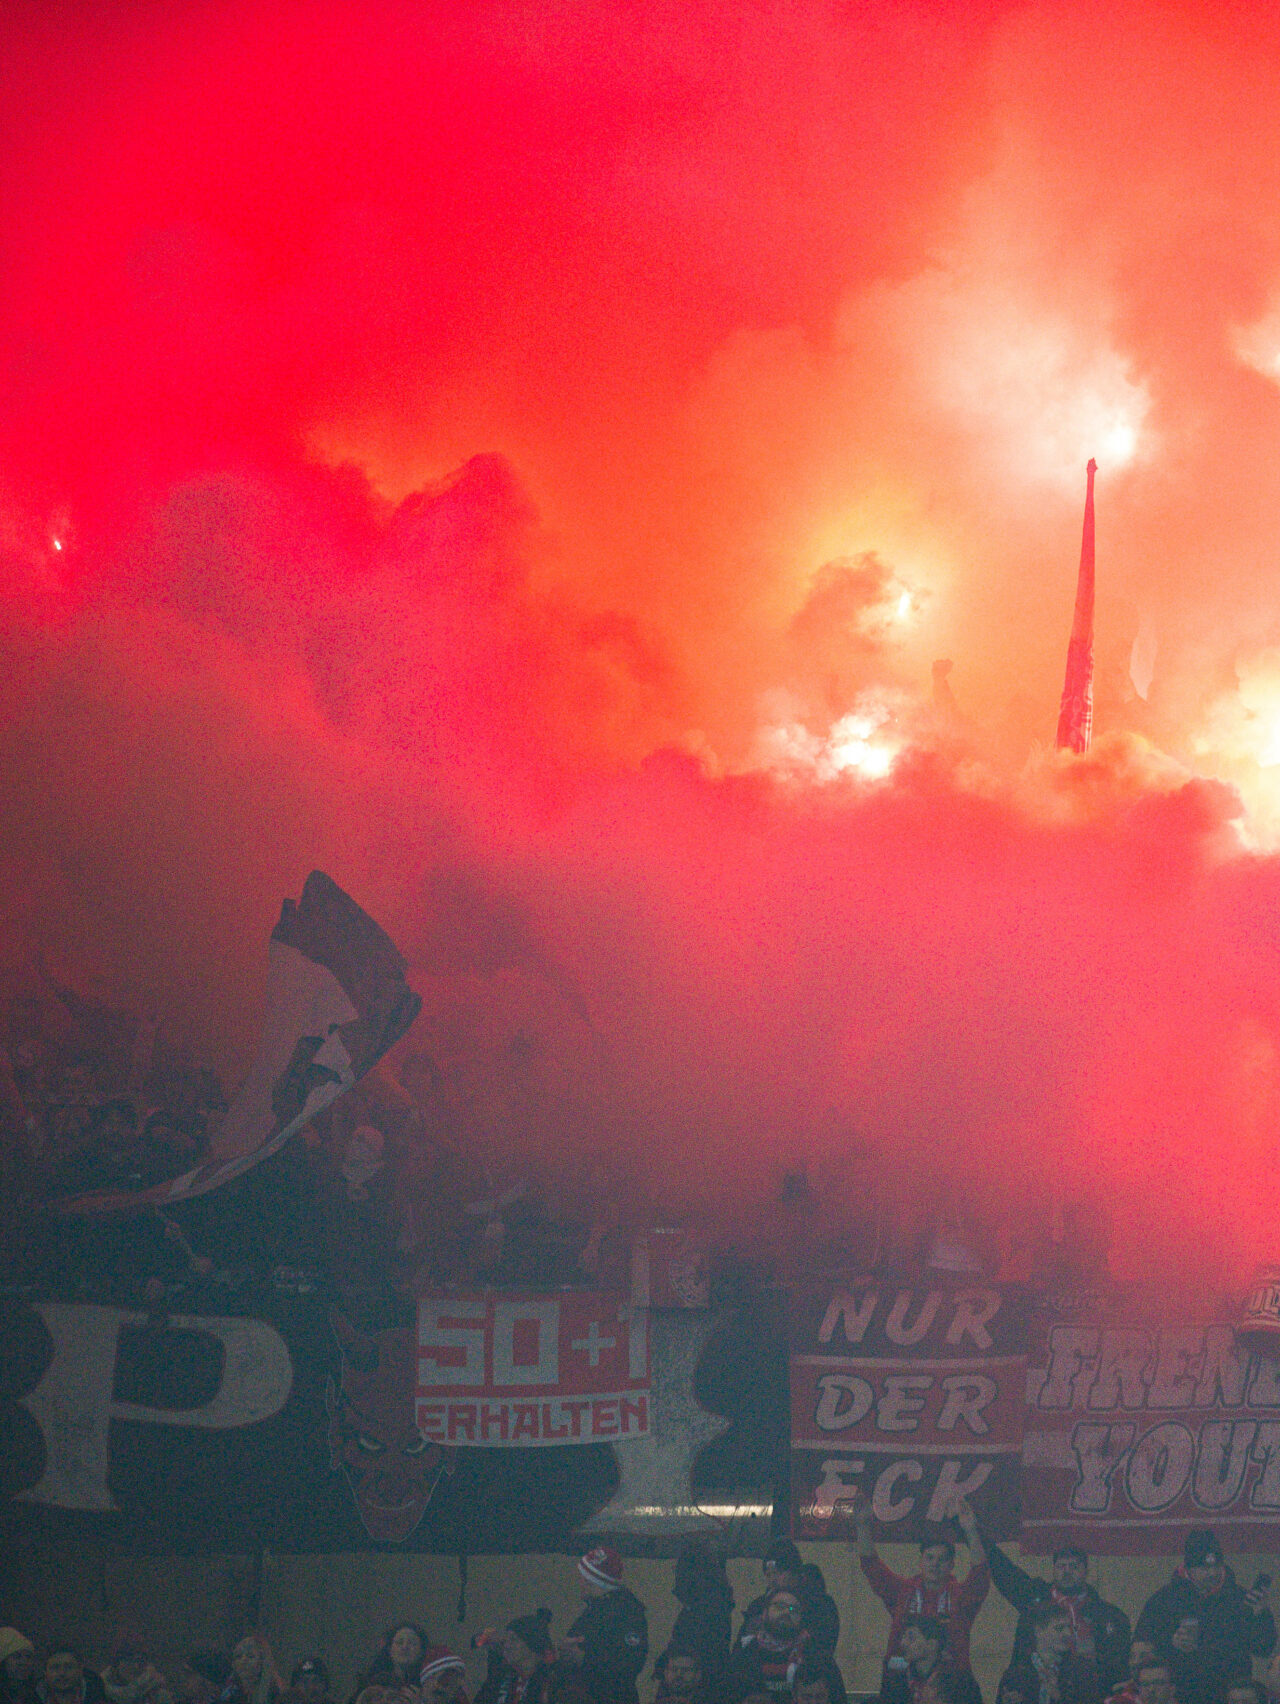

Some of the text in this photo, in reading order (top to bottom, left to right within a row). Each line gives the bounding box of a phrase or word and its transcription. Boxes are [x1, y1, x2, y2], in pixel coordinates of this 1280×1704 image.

[418, 1301, 650, 1387] 50+1
[818, 1288, 1001, 1350] NUR
[424, 1396, 648, 1441] ERHALTEN
[815, 1374, 998, 1434] DER
